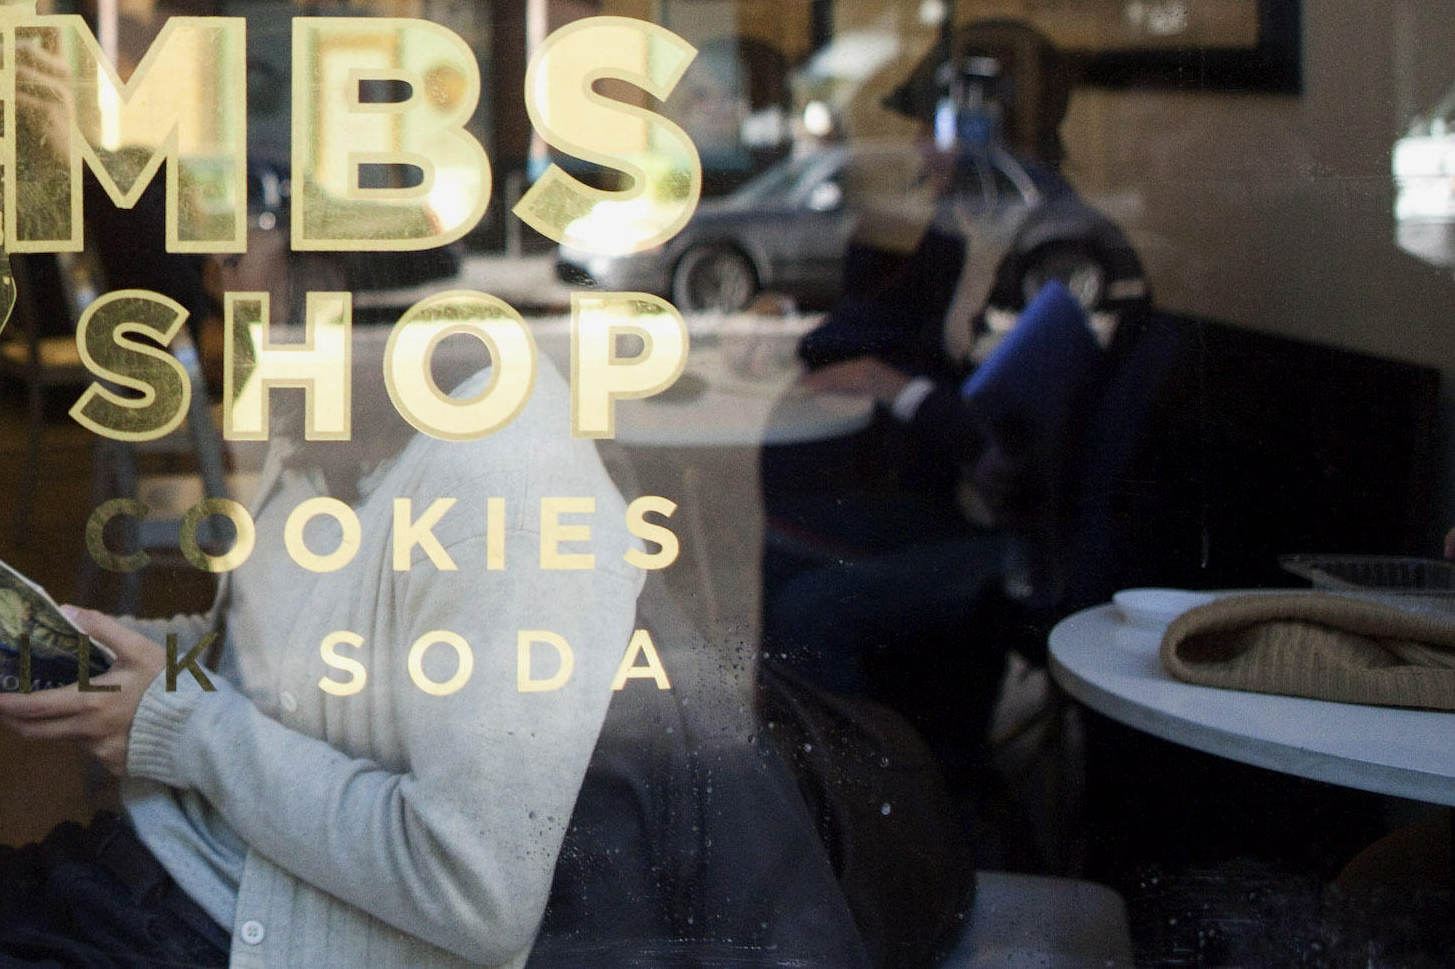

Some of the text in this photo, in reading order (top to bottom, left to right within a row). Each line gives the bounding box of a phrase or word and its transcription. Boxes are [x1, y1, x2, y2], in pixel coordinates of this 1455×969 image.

[68, 289, 690, 442] SHOP
[85, 495, 680, 573] COOKIES
[318, 630, 671, 696] SODA
